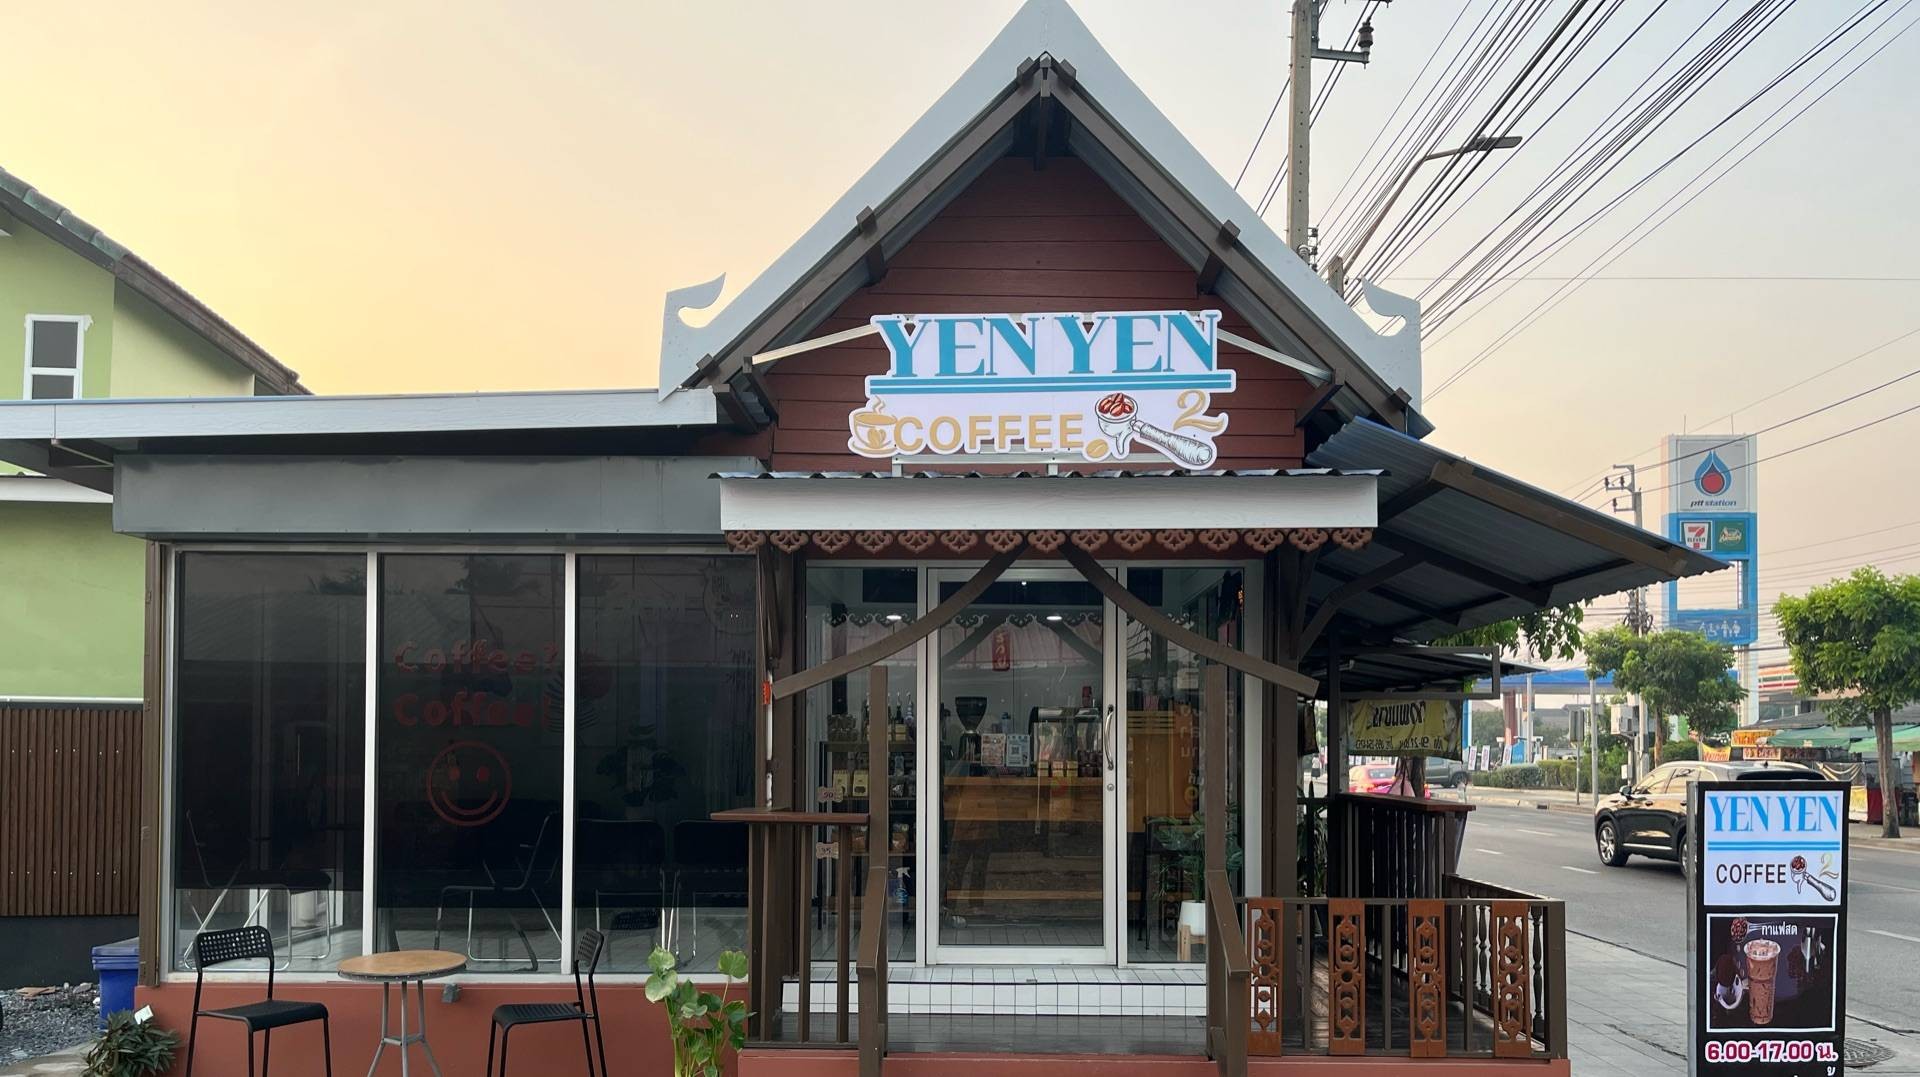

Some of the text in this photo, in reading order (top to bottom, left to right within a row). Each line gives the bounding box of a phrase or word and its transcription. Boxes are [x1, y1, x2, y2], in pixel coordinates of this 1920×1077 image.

[875, 313, 1219, 378] YEN YEN
[894, 389, 1225, 451] COFFEE 2
[1690, 499, 1737, 508] ptt station
[1707, 796, 1838, 832] YEN YEN
[1716, 852, 1839, 884] COFFEE 2
[1761, 920, 1798, 936] กาแฟสด
[1706, 1041, 1838, 1061] 6.00-17.00 น.
